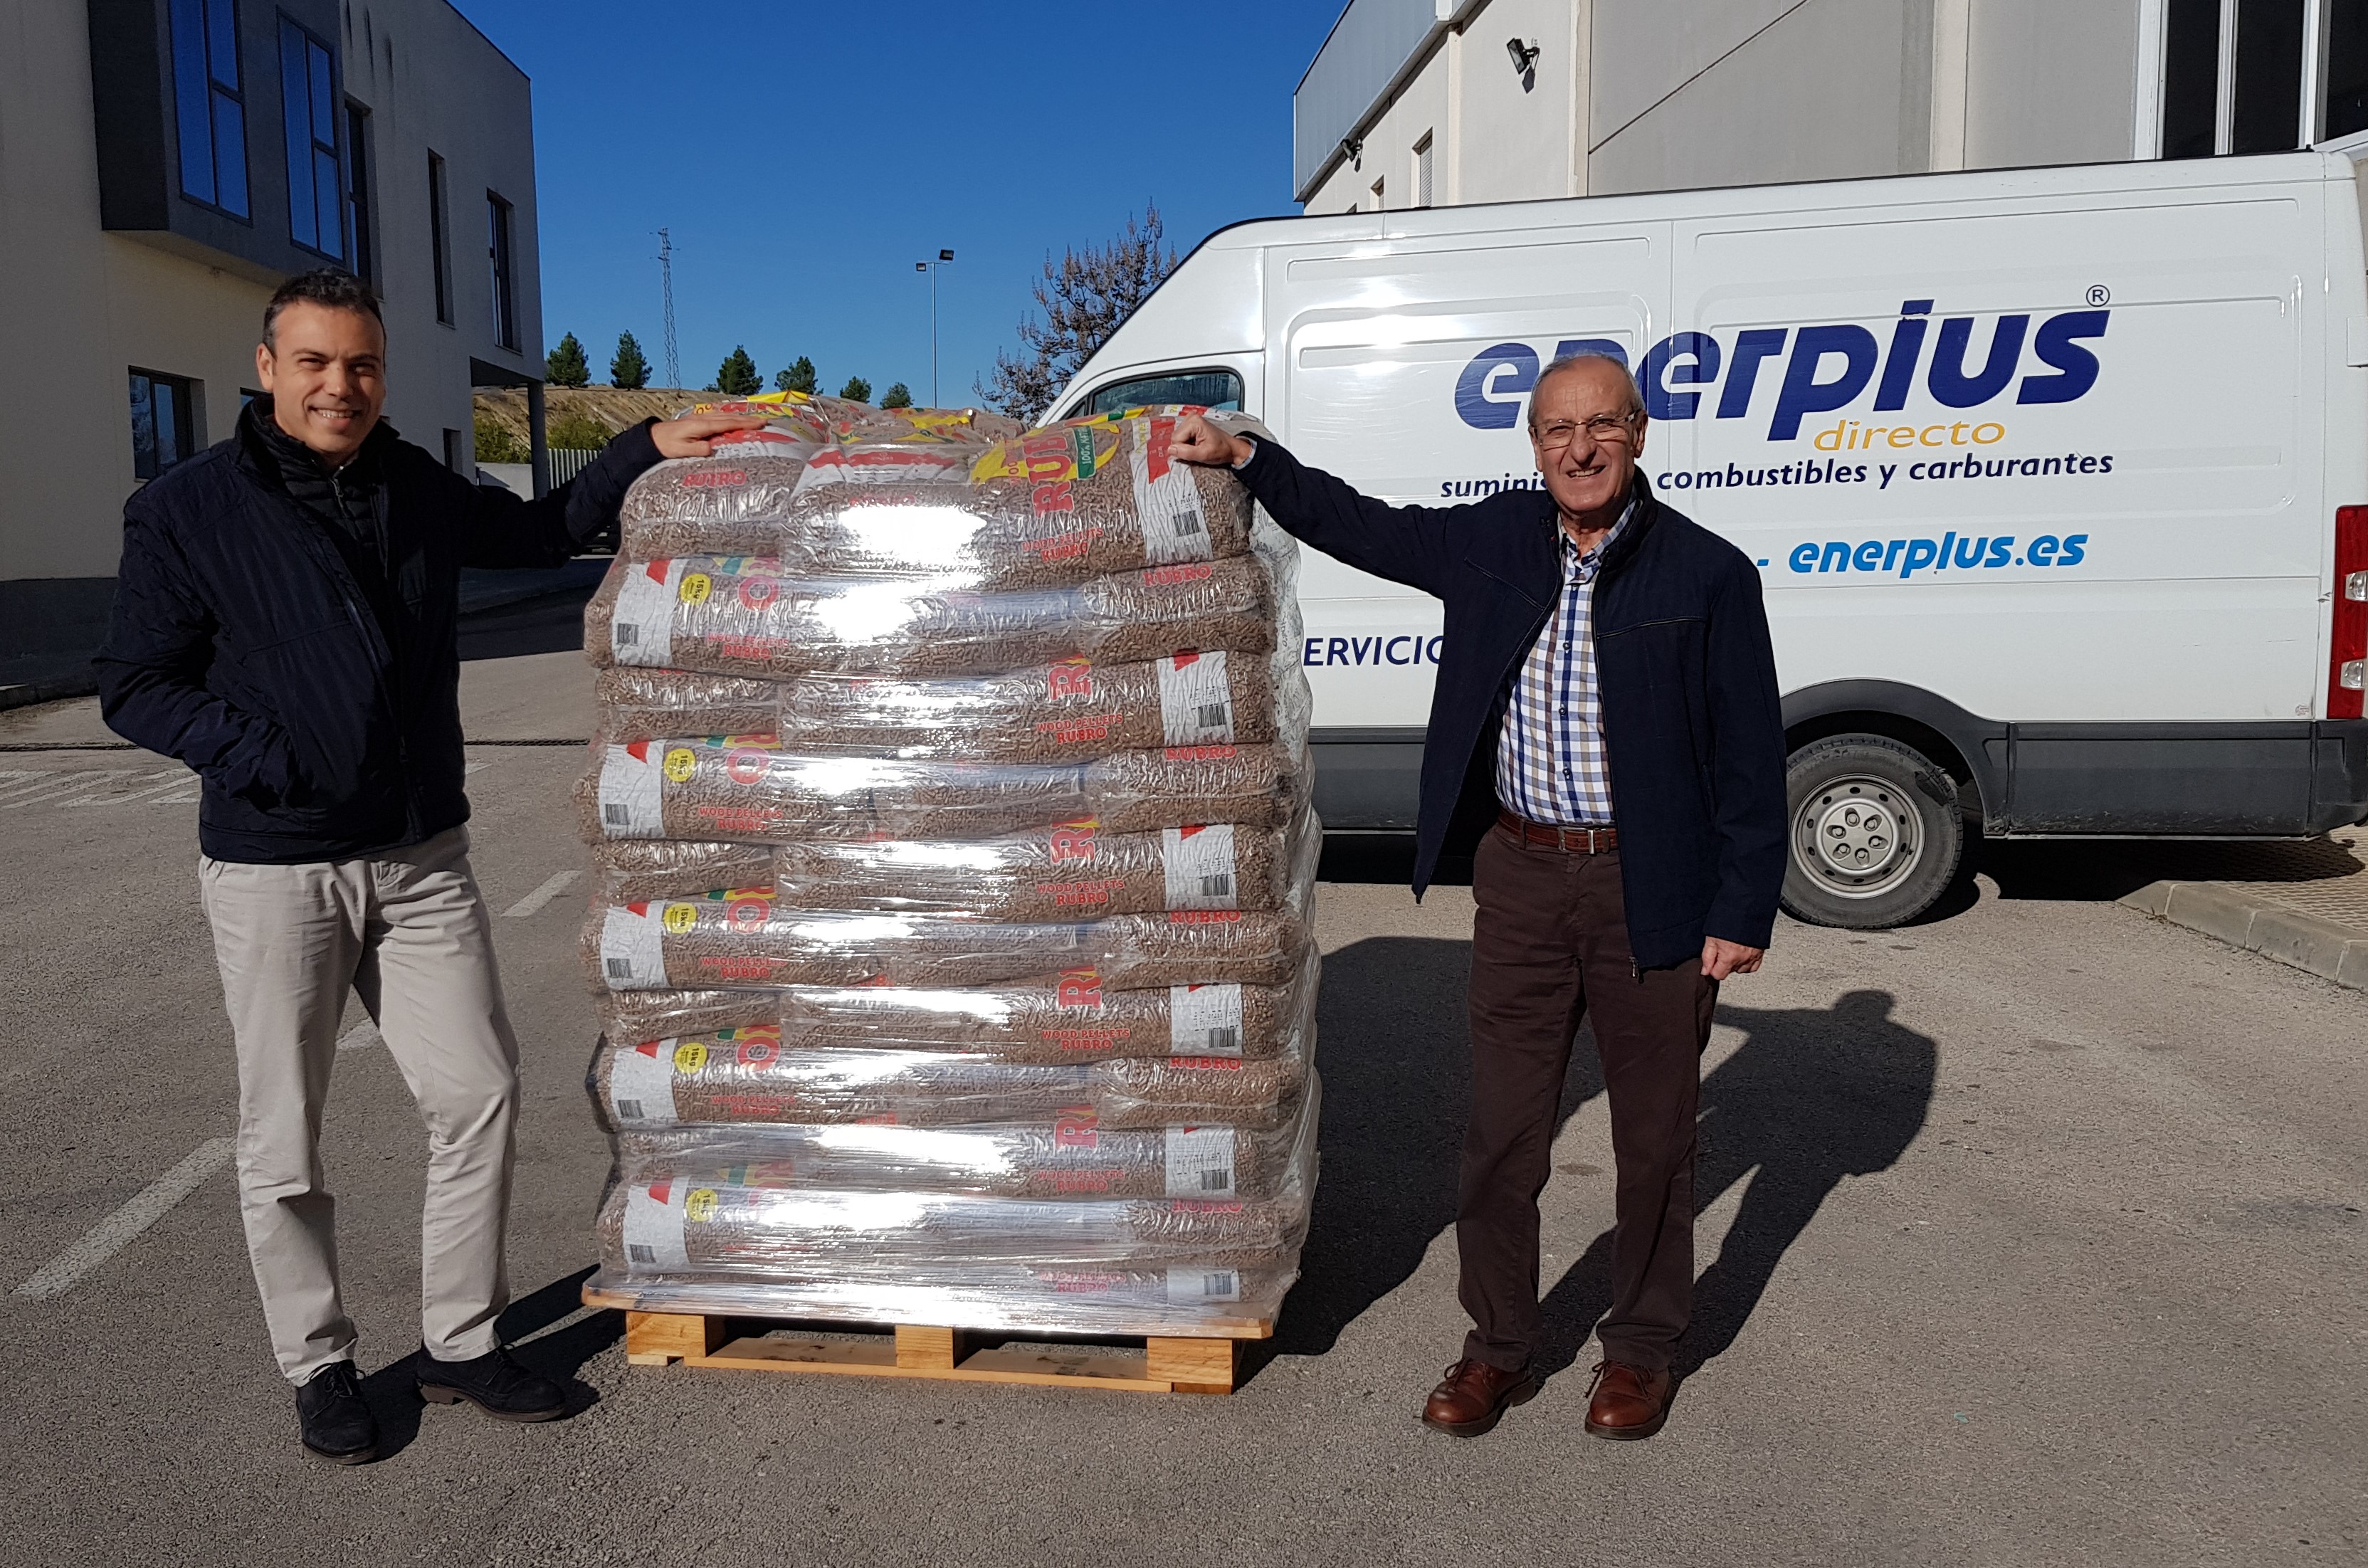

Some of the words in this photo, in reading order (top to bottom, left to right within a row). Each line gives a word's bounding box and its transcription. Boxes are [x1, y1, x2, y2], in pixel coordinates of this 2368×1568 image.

[1814, 419, 2005, 451] directo
[1022, 436, 1075, 517] RUB
[1441, 471, 1547, 497] sumini
[1657, 458, 1868, 489] combustibles
[1879, 464, 1898, 490] y
[1909, 452, 2114, 480] carburantes
[1789, 531, 2089, 579] enerplus.es
[722, 643, 772, 660] RUBRO
[1036, 721, 1072, 732] WOOD
[1075, 712, 1123, 727] PELLETS
[1056, 726, 1107, 744] RUBRO
[1164, 745, 1237, 762] RUBRO
[699, 806, 732, 818] WOOD
[1036, 883, 1072, 894] WOOD
[1075, 879, 1125, 892] PELLETS
[1056, 891, 1109, 906] RUBRO
[1169, 910, 1241, 925] RUBRO
[701, 957, 736, 966] WOOD
[720, 966, 771, 979] RUBRO
[1041, 1029, 1078, 1039] WOOD
[1081, 1028, 1131, 1038] PELLETS
[1061, 1038, 1113, 1051] RUBRO
[689, 1047, 700, 1067] 15kg
[1169, 1056, 1242, 1070] RUBRO
[712, 1095, 747, 1105] WOOD
[731, 1105, 780, 1115] RUBRO
[1038, 1169, 1073, 1179] WOOD
[1075, 1169, 1125, 1179] PELLETS
[1056, 1180, 1110, 1192] RUBRO
